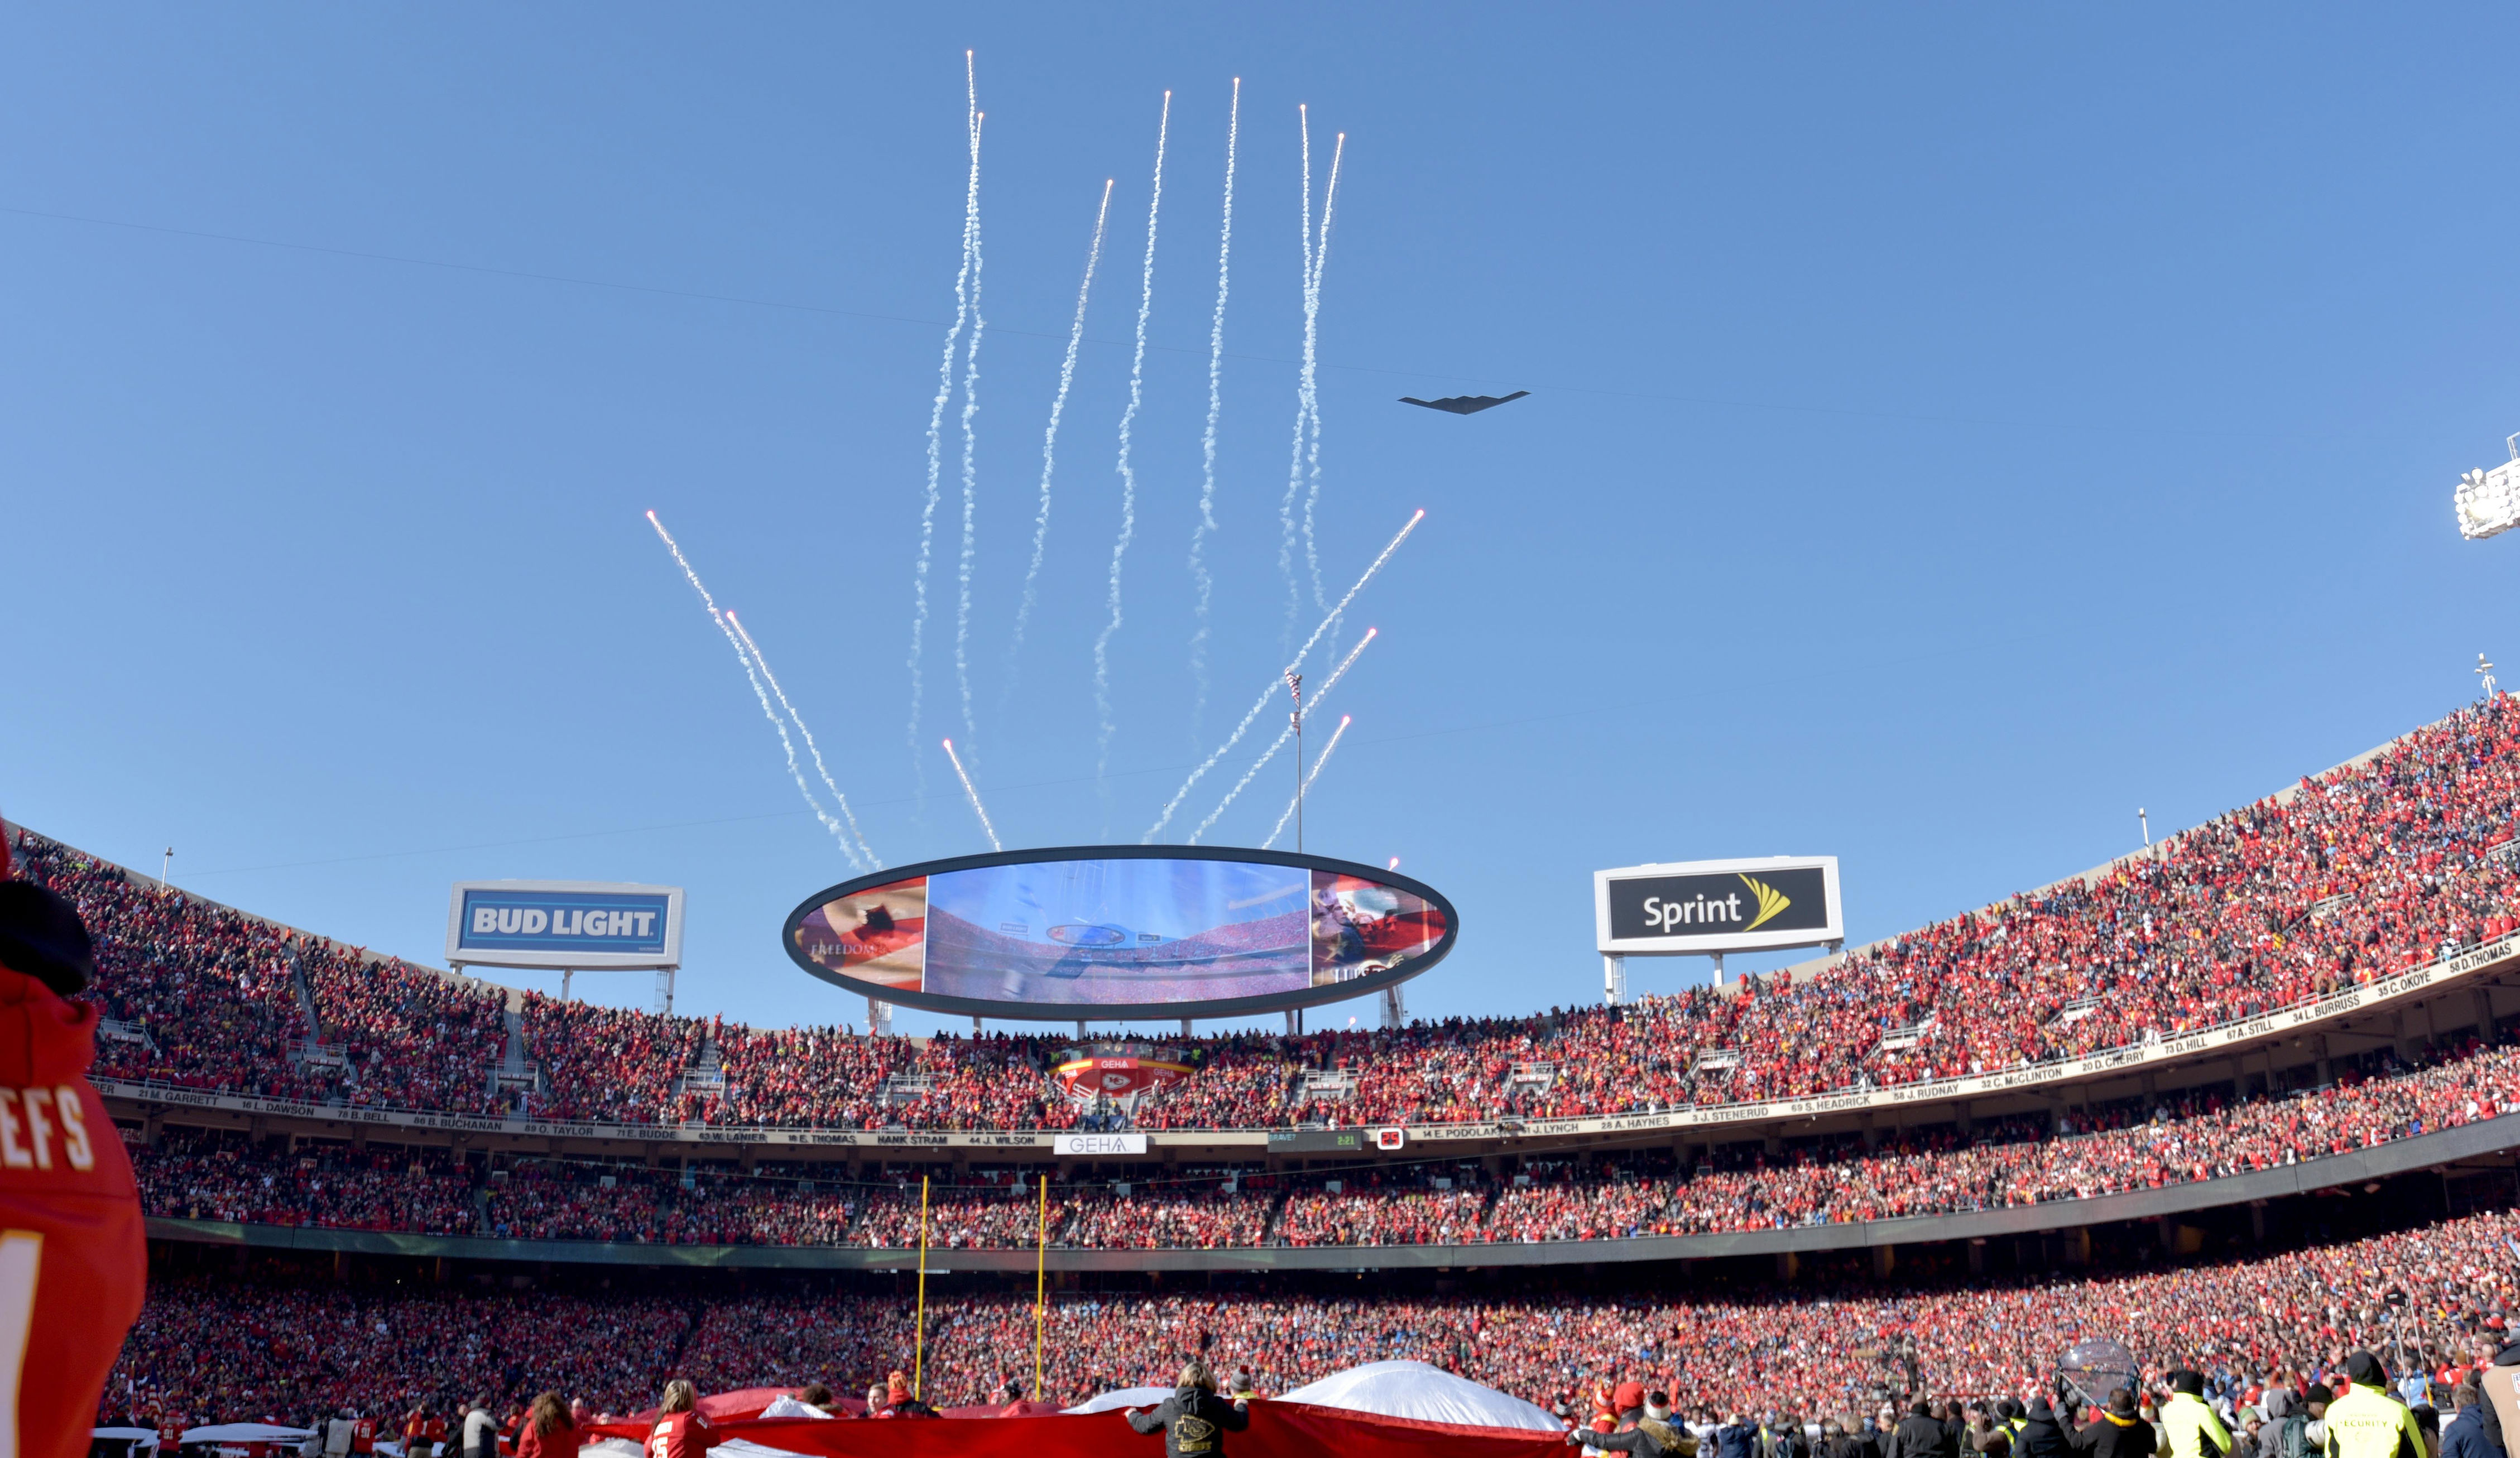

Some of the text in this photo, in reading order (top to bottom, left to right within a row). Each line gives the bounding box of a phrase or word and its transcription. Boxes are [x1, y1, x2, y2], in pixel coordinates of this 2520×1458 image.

[1644, 893, 1742, 933] Sprint
[473, 908, 655, 936] BUD LIGHT
[2470, 942, 2512, 967] THOMAS
[2401, 971, 2431, 990] OKOYE
[2316, 994, 2360, 1017] BURRUSS
[2249, 1020, 2274, 1034] STILL
[2186, 1037, 2208, 1050] HILL
[1101, 1060, 1129, 1069] GEHA
[2106, 1051, 2145, 1067] CHERRY
[1153, 1068, 1175, 1077] GEHA
[2005, 1067, 2062, 1085] McCLINTON
[165, 1091, 219, 1105] GARRETT
[1918, 1085, 1959, 1098] RUDNAY
[1817, 1095, 1871, 1110] HEADRICK
[266, 1103, 314, 1116] DAWSON
[1712, 1108, 1768, 1121] STENERUD
[364, 1112, 390, 1122] BELL
[1628, 1117, 1669, 1128] HAYNES
[440, 1118, 502, 1130] BUCHANAN
[1544, 1123, 1578, 1133] LYNCH
[553, 1126, 593, 1136] TAYLOR
[639, 1130, 676, 1139] BUDDE
[727, 1133, 767, 1142] LANIER
[812, 1135, 856, 1144] THOMAS
[878, 1135, 947, 1144] HANK STRAM
[996, 1136, 1035, 1144] WILSON
[1070, 1137, 1126, 1152] GEHA
[1337, 1135, 1355, 1146] 2:21
[1381, 1132, 1399, 1146] 25
